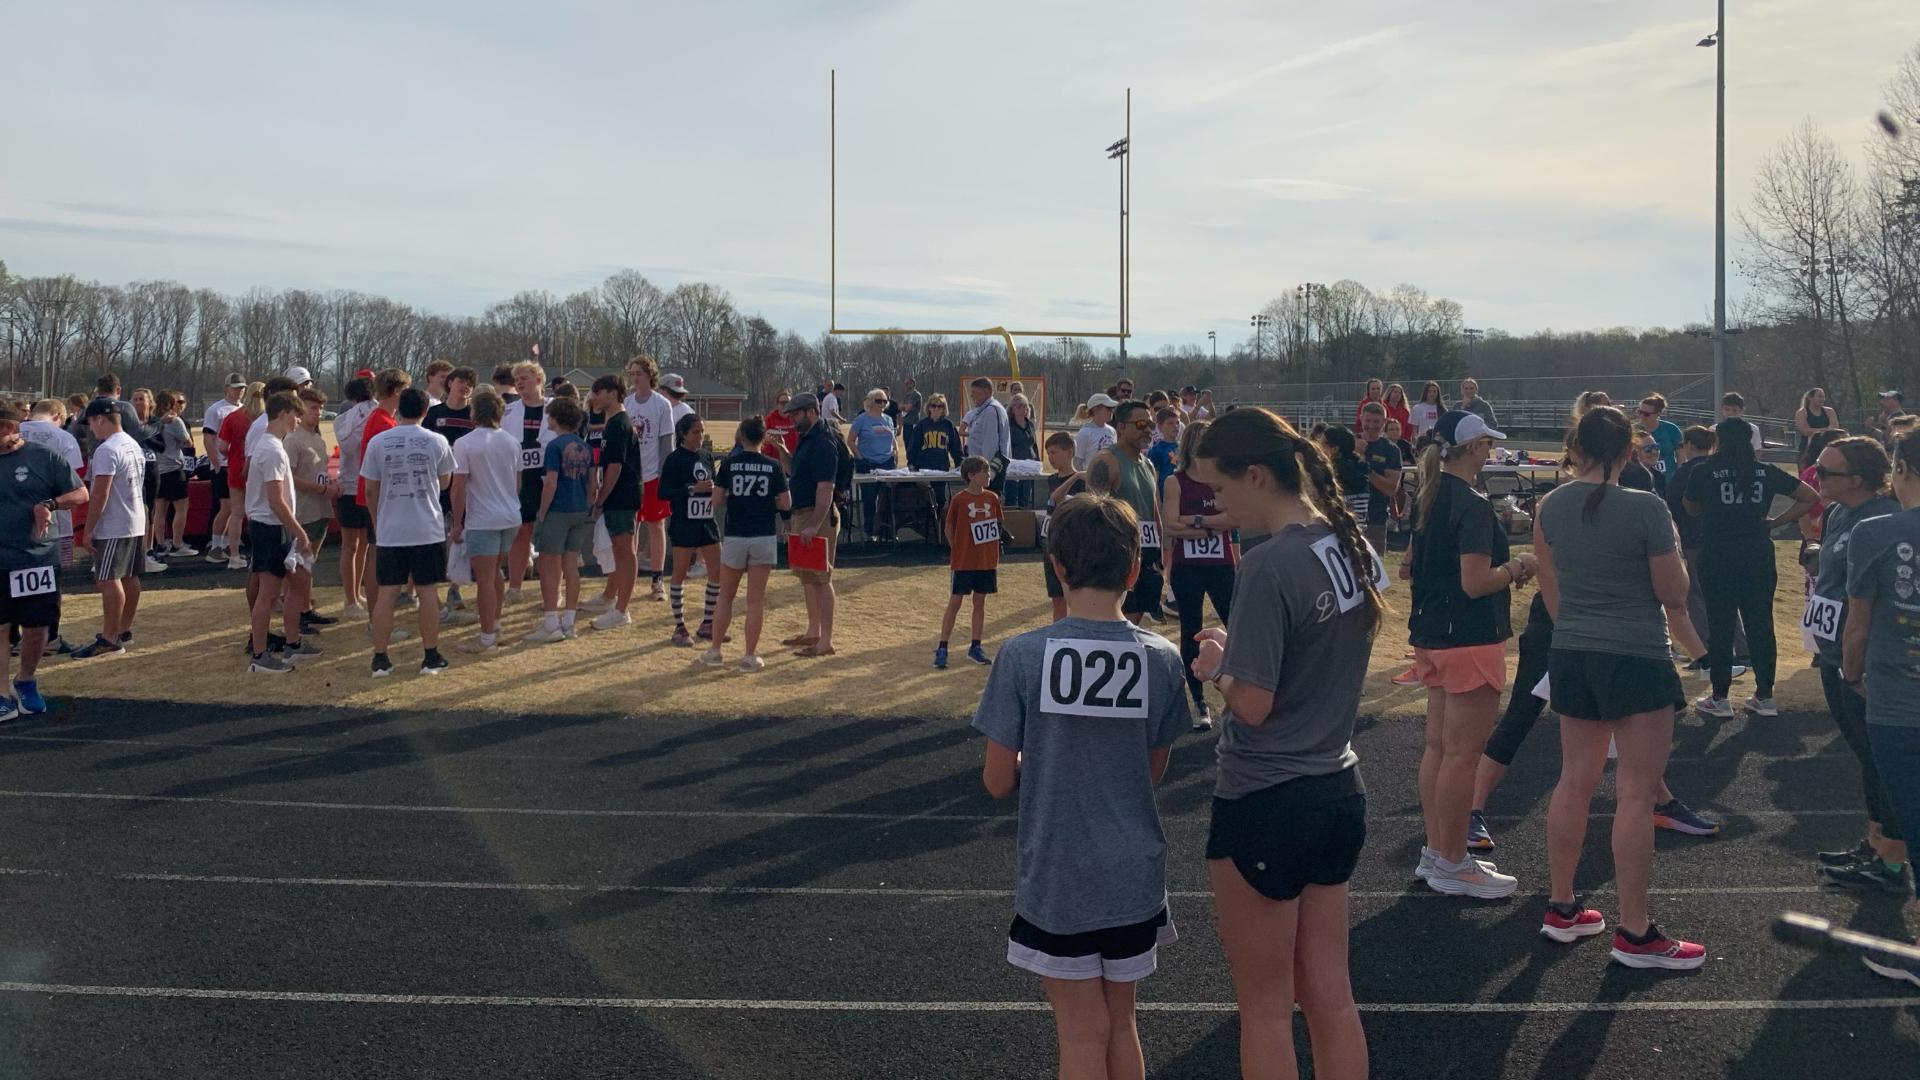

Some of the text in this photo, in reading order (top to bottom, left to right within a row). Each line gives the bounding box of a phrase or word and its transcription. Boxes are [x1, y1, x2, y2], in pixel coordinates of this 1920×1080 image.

[522, 450, 540, 467] 99
[732, 474, 769, 497] 873
[691, 500, 712, 516] 014
[974, 521, 997, 541] 075
[1141, 524, 1157, 544] 91
[1187, 535, 1221, 555] 192
[14, 569, 52, 593] 104
[1804, 600, 1836, 635] 043
[1050, 647, 1142, 708] 022
